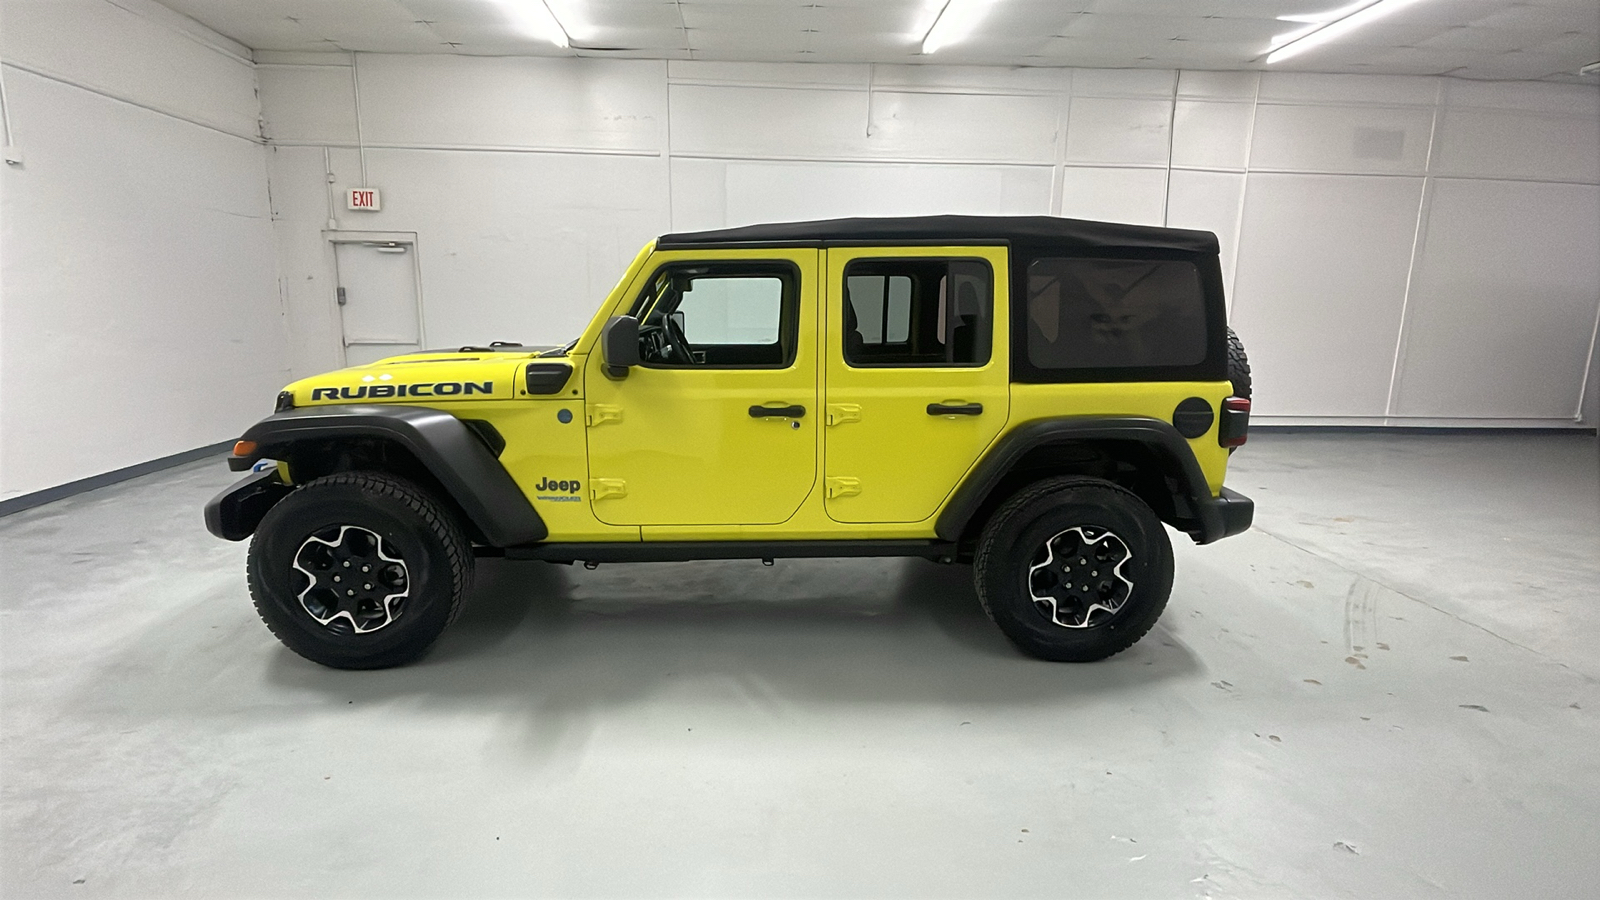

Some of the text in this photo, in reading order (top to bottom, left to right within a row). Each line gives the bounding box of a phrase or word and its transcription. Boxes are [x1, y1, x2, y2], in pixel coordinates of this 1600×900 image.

[353, 191, 373, 207] EXIT
[312, 382, 493, 400] RUBICON
[536, 477, 581, 494] Jeep
